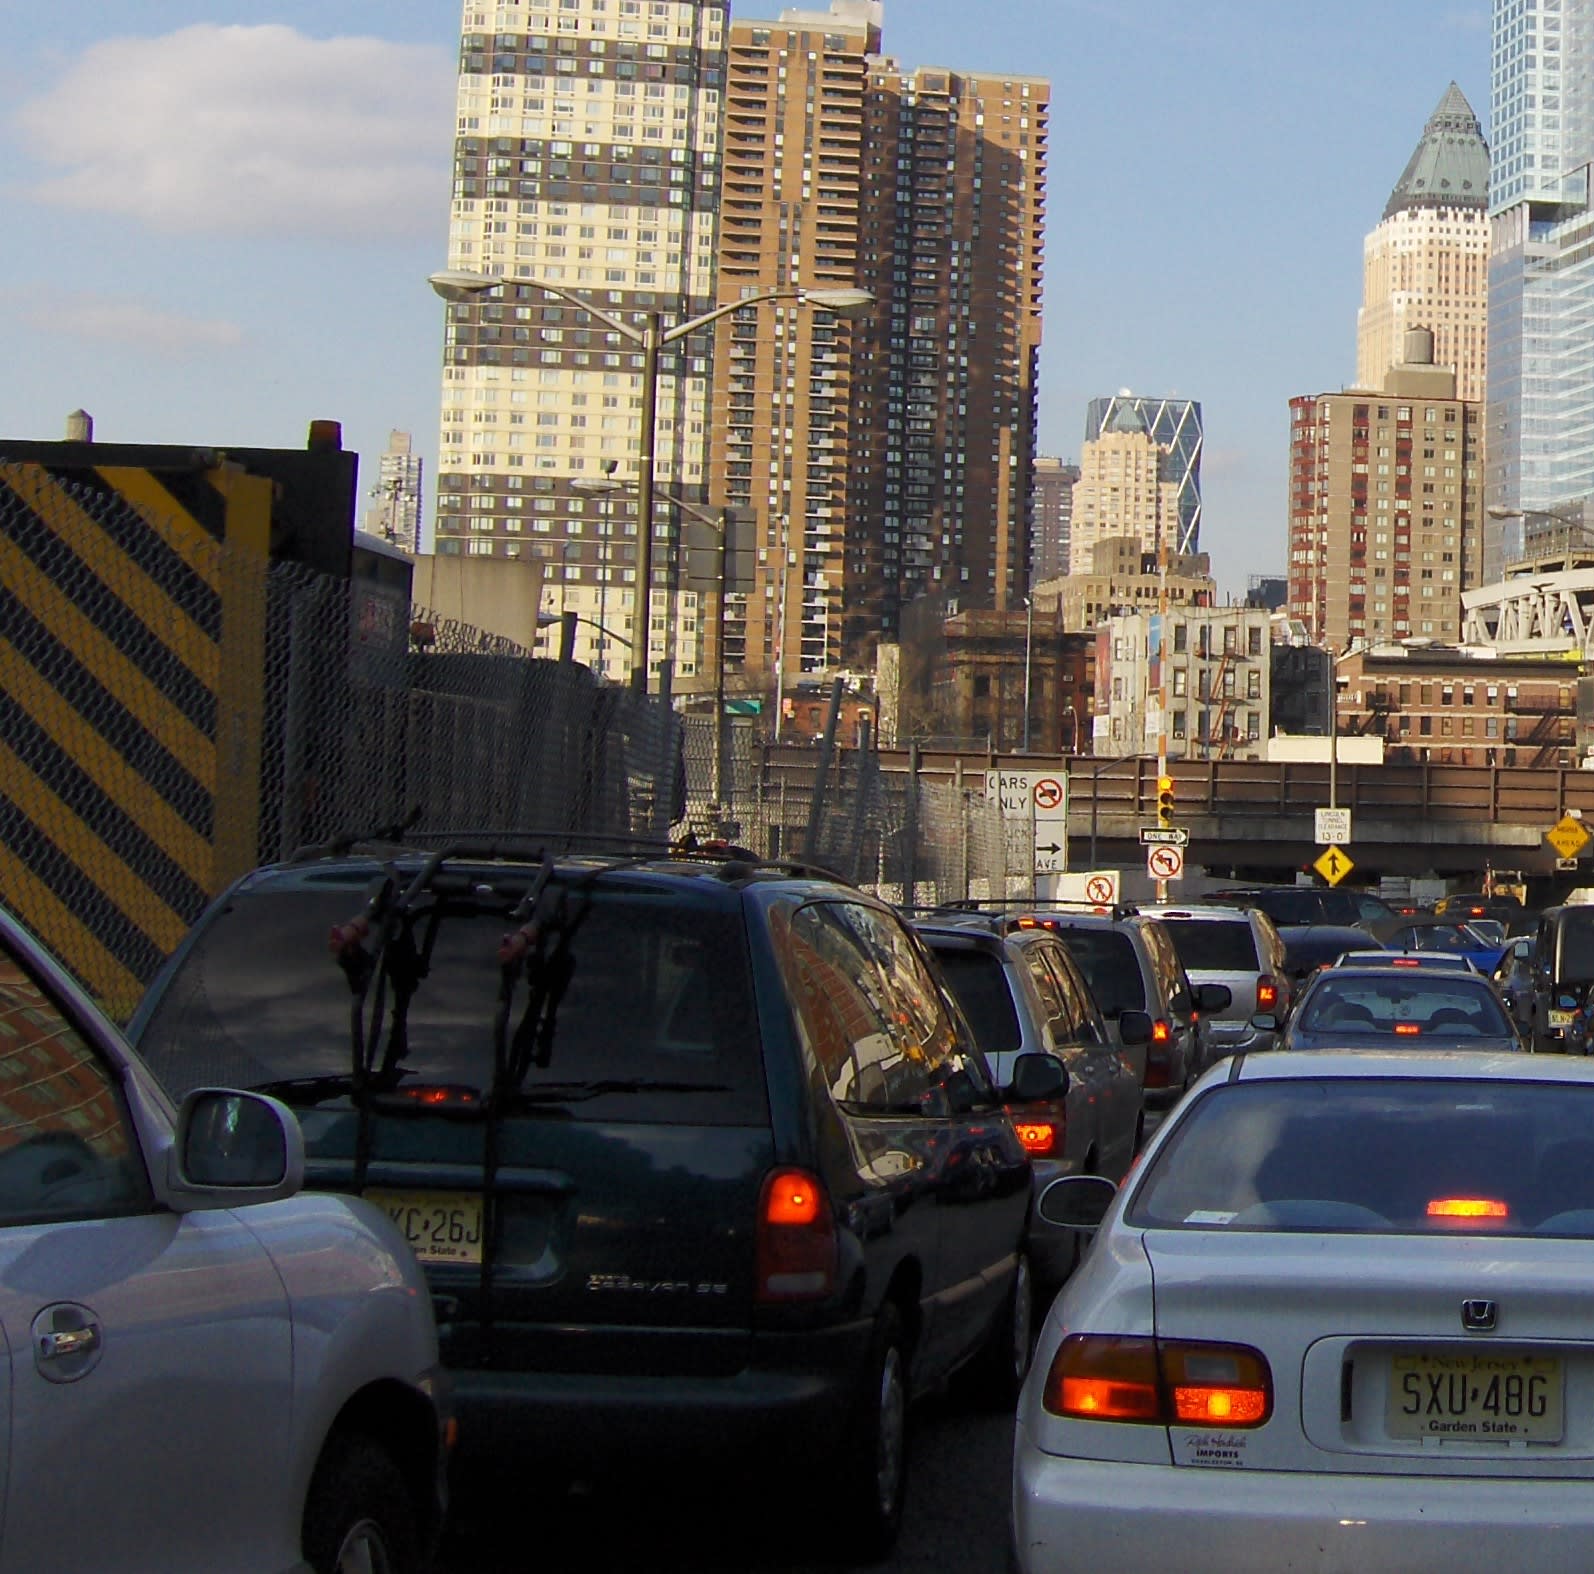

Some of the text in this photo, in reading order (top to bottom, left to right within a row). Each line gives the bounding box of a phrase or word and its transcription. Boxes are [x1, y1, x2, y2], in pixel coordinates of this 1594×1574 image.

[988, 777, 1028, 789] CARS
[989, 797, 1027, 809] NLY
[1147, 832, 1184, 841] ONE WAY
[1036, 860, 1057, 870] AVE
[1432, 1354, 1519, 1373] New Jersey
[1429, 1420, 1517, 1434] Garden State
[1196, 1449, 1239, 1459] IMPORTS
